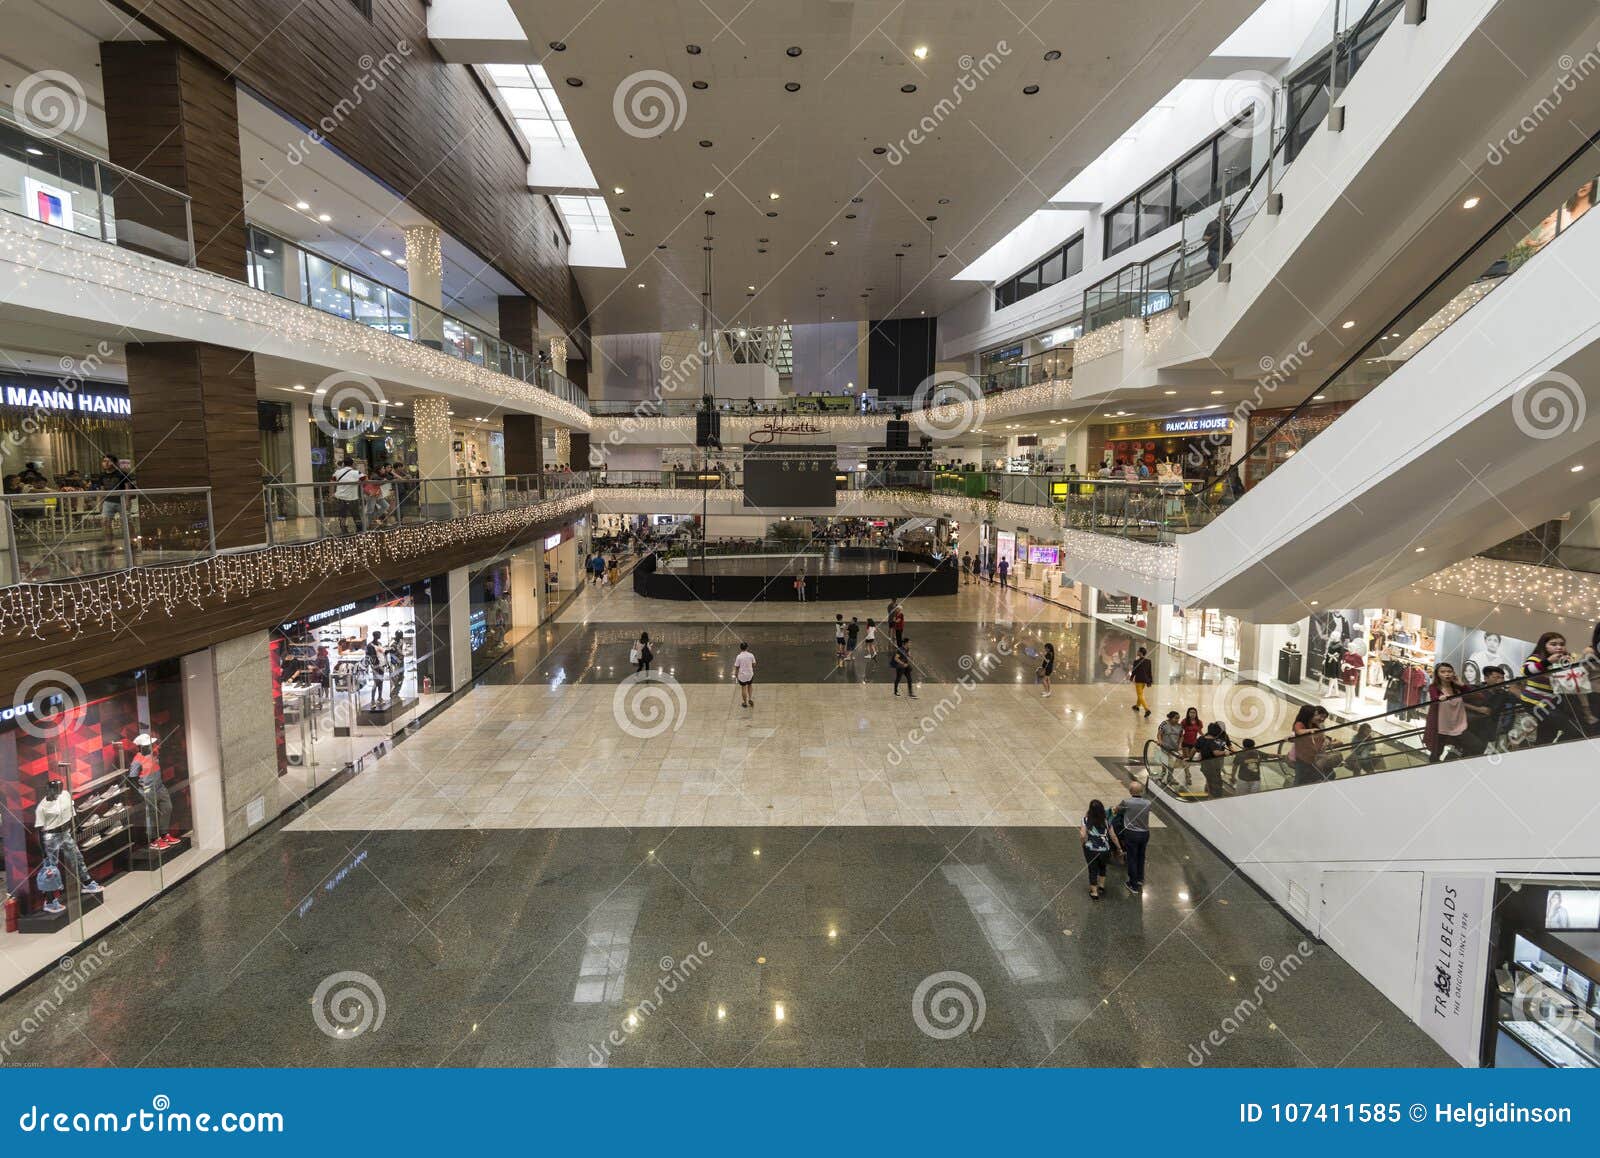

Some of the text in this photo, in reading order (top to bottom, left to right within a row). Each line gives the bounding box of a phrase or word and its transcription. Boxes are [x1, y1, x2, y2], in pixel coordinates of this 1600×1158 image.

[7, 386, 74, 410] MANN
[78, 393, 132, 415] HANN
[1166, 418, 1227, 431] PANCAKE HOUSE
[1458, 934, 1467, 957] SINCE
[1455, 959, 1465, 998] ORIGINAL
